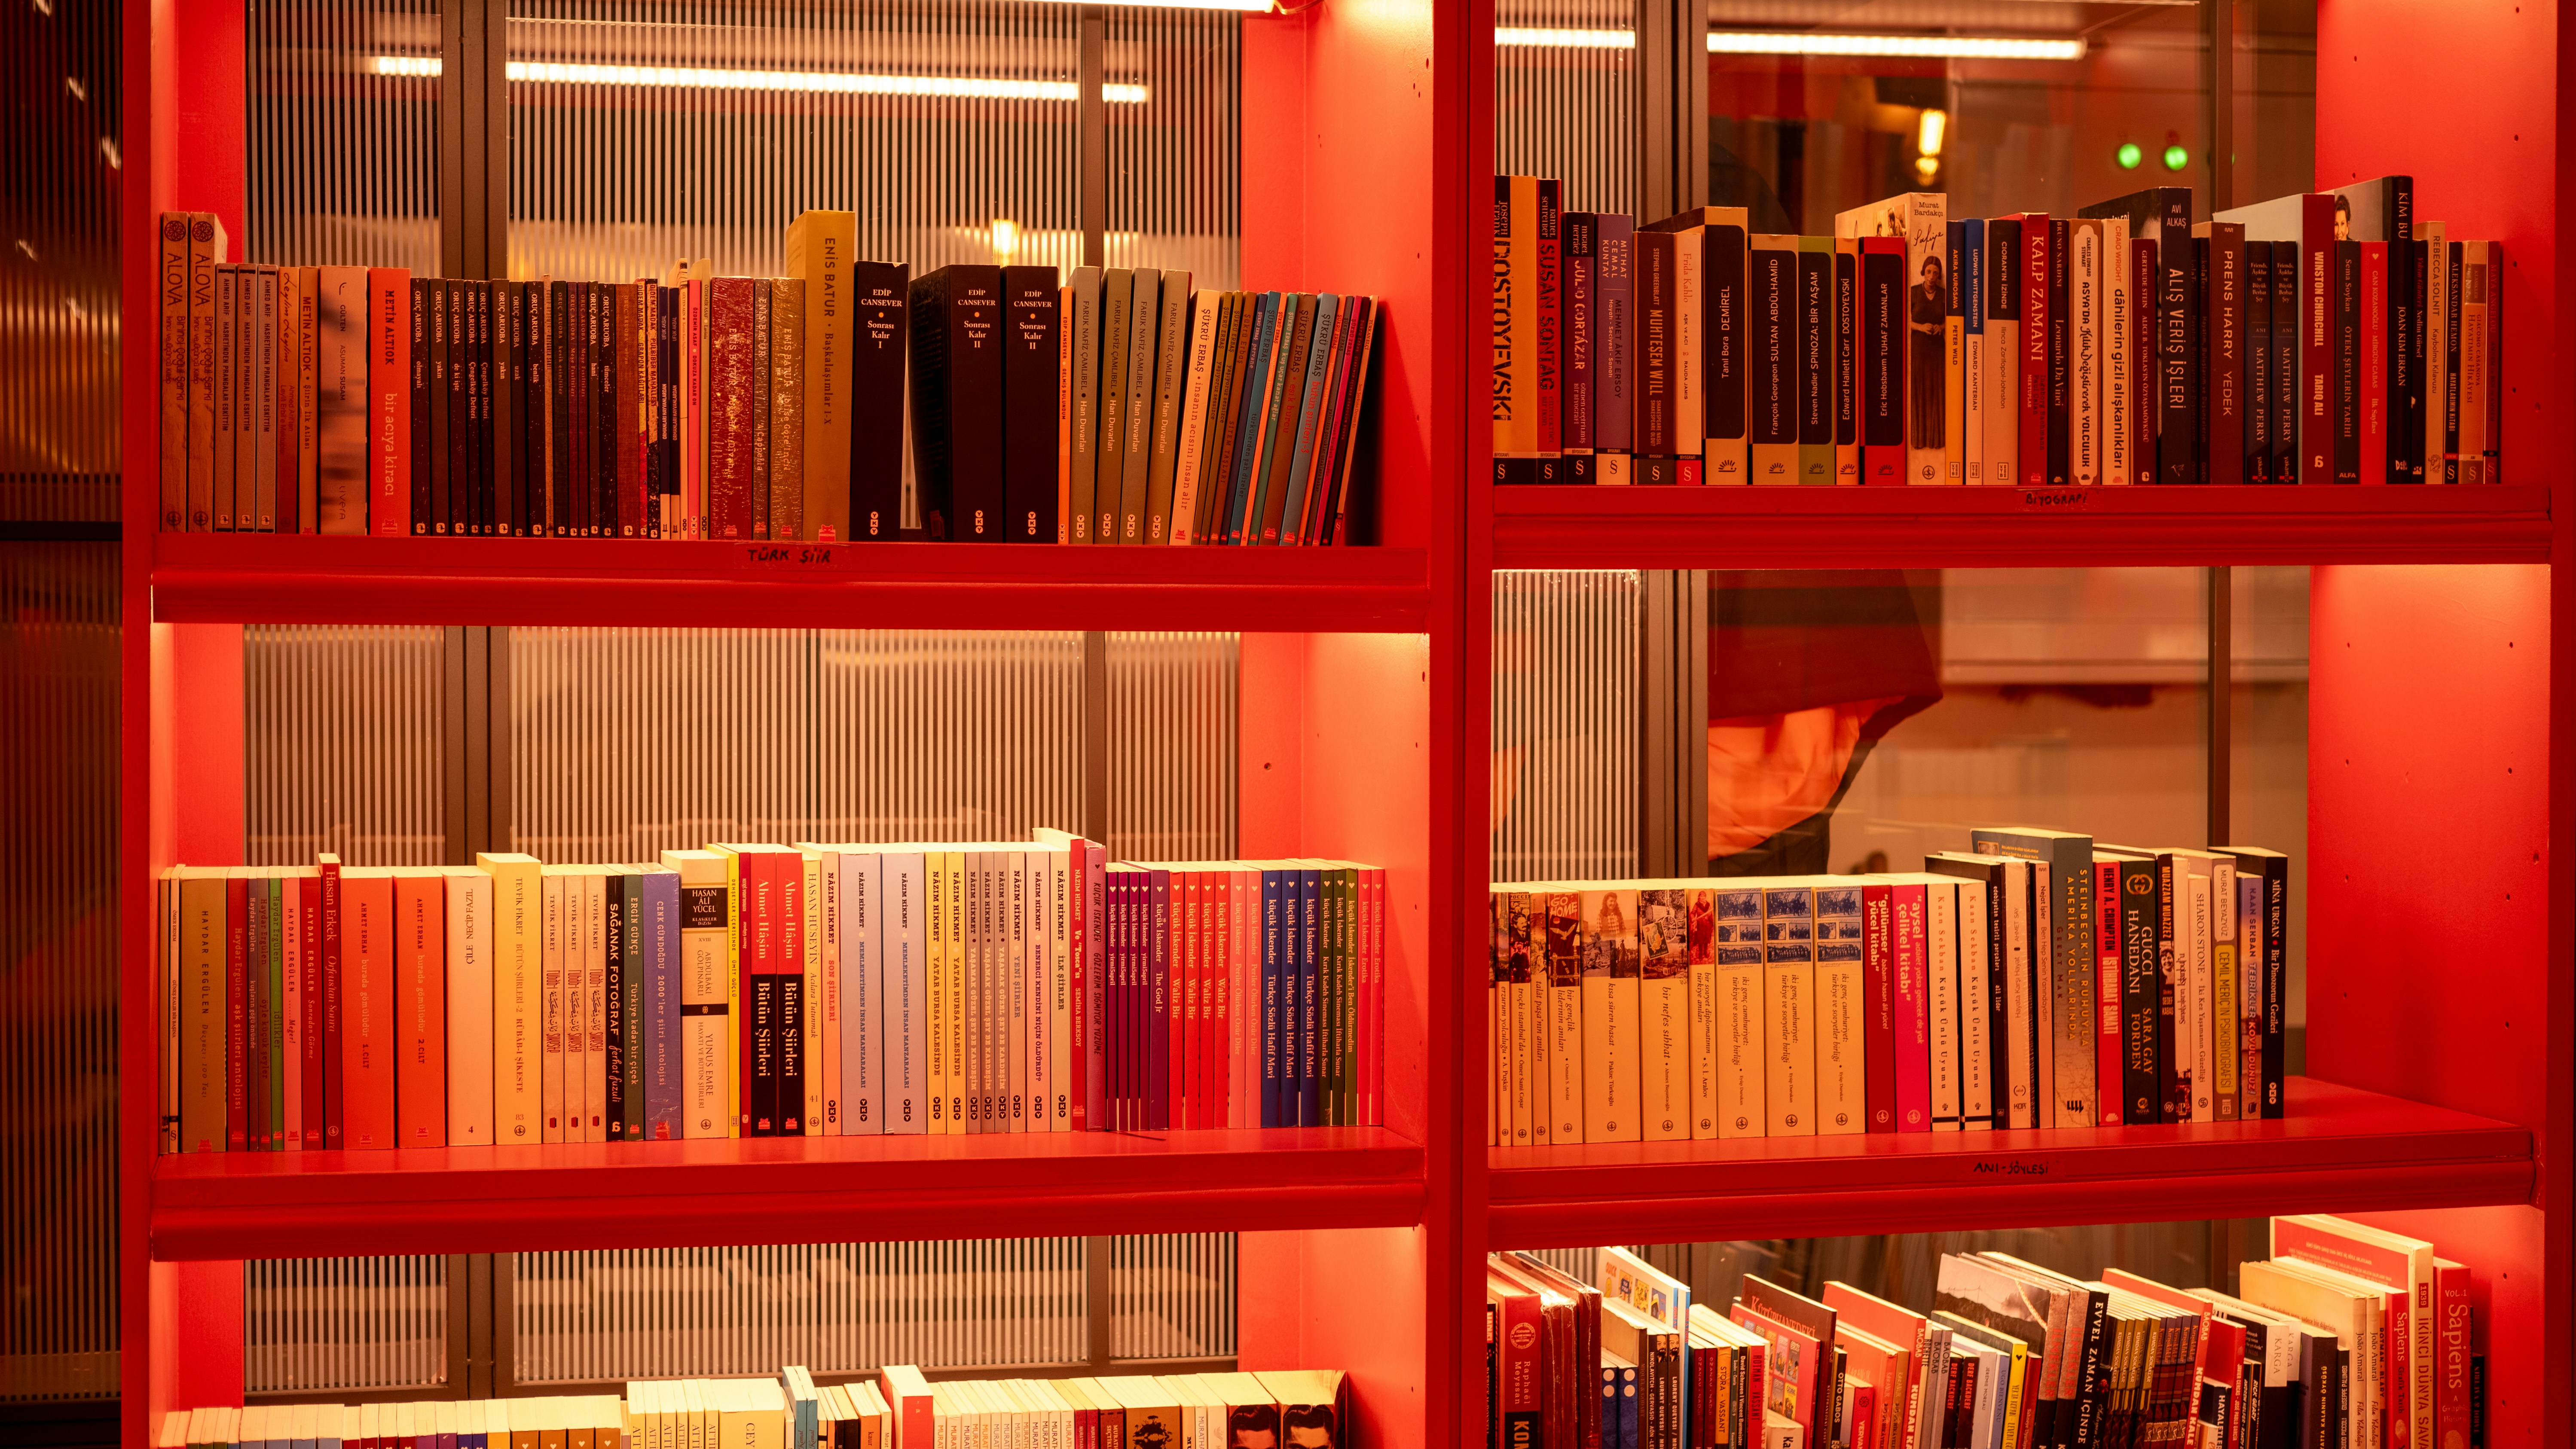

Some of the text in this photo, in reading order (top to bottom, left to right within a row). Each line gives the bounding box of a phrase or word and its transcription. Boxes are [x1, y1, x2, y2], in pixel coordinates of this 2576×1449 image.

[1914, 209, 1943, 218] Bardakçı
[2167, 217, 2186, 229] ALKAŞ
[2171, 204, 2181, 214] AVİ
[2398, 192, 2409, 238] KİM BU
[167, 253, 183, 307] ALOVA
[195, 253, 211, 307] ALOVA
[824, 238, 837, 317] ENİS BATUR
[1769, 259, 1778, 322] ABDÜLHAMİD
[1810, 272, 1820, 305] YAŞAM
[2031, 235, 2044, 361] KALP ZAMANI
[861, 299, 902, 307] CANSEVER
[868, 320, 894, 329] Sonrası
[1538, 244, 1555, 390] SUSAN SONTAG
[1720, 286, 1730, 330] DEMİREL
[1809, 308, 1818, 323] BİR
[303, 297, 313, 371] METİN ALTIOK
[872, 330, 890, 339] Kalır
[1194, 309, 1212, 372] ŞÜKRÜ ERBAŞ
[1615, 343, 1623, 365] ÂKİF
[1648, 310, 1663, 395] MUHTEŞEM WILL
[1770, 326, 1778, 361] SULTAN
[1810, 326, 1818, 369] SPINOZA:
[2167, 268, 2187, 408] ALIŞ VERİŞ İŞLERİ
[2223, 251, 2233, 416] PRENS HARRY YEDEK
[2313, 252, 2324, 415] WINSTON CHURCHILL TARIQ ALI
[382, 290, 396, 496] METİN ALTIOK bir acıya kiracı
[1080, 352, 1088, 390] ÇAMLIBEL
[1771, 403, 1779, 435] François
[747, 546, 789, 561] TÜRK
[326, 871, 337, 941] Hasan Erkek
[692, 889, 717, 899] HASAN
[693, 903, 716, 913] YÜCEL
[698, 895, 710, 905] ÂLİ
[1155, 903, 1164, 928] küçük
[1550, 896, 1568, 907] GO
[1156, 930, 1165, 963] İskender
[2128, 910, 2140, 994] HANEDANI
[2141, 926, 2153, 976] GUCCI
[2196, 894, 2205, 973] SHARON STONE
[202, 964, 211, 1014] ERGÜLEN
[610, 903, 621, 1036] SAĞANAK FOTOĞRAF
[756, 882, 770, 1076] Ahmet Hâşim Bütün Şiirleri
[1266, 899, 1277, 1079] küçük İskender Türkçe Sözlü Hafif Mavi
[827, 980, 837, 1022] ŞİİRLERİ
[2131, 1013, 2141, 1069] FORDEN
[2142, 1008, 2152, 1074] SARA GAY
[2445, 1289, 2467, 1297] VOL.1
[1915, 1328, 1925, 1358] BAOBAB
[2273, 1338, 2282, 1374] KARGA
[2370, 1332, 2378, 1350] João
[2394, 1312, 2408, 1361] Sapiens
[2442, 1304, 2468, 1389] Sapiens
[1513, 1361, 1522, 1404] Meyssan
[1522, 1361, 1531, 1404] Raphaël
[2078, 1301, 2104, 1444] EVVEL ZAMAN İÇİNDE
[2418, 1318, 2429, 1411] İKİNCİ DÜNYA
[1834, 1371, 1845, 1425] OTTO GABOS
